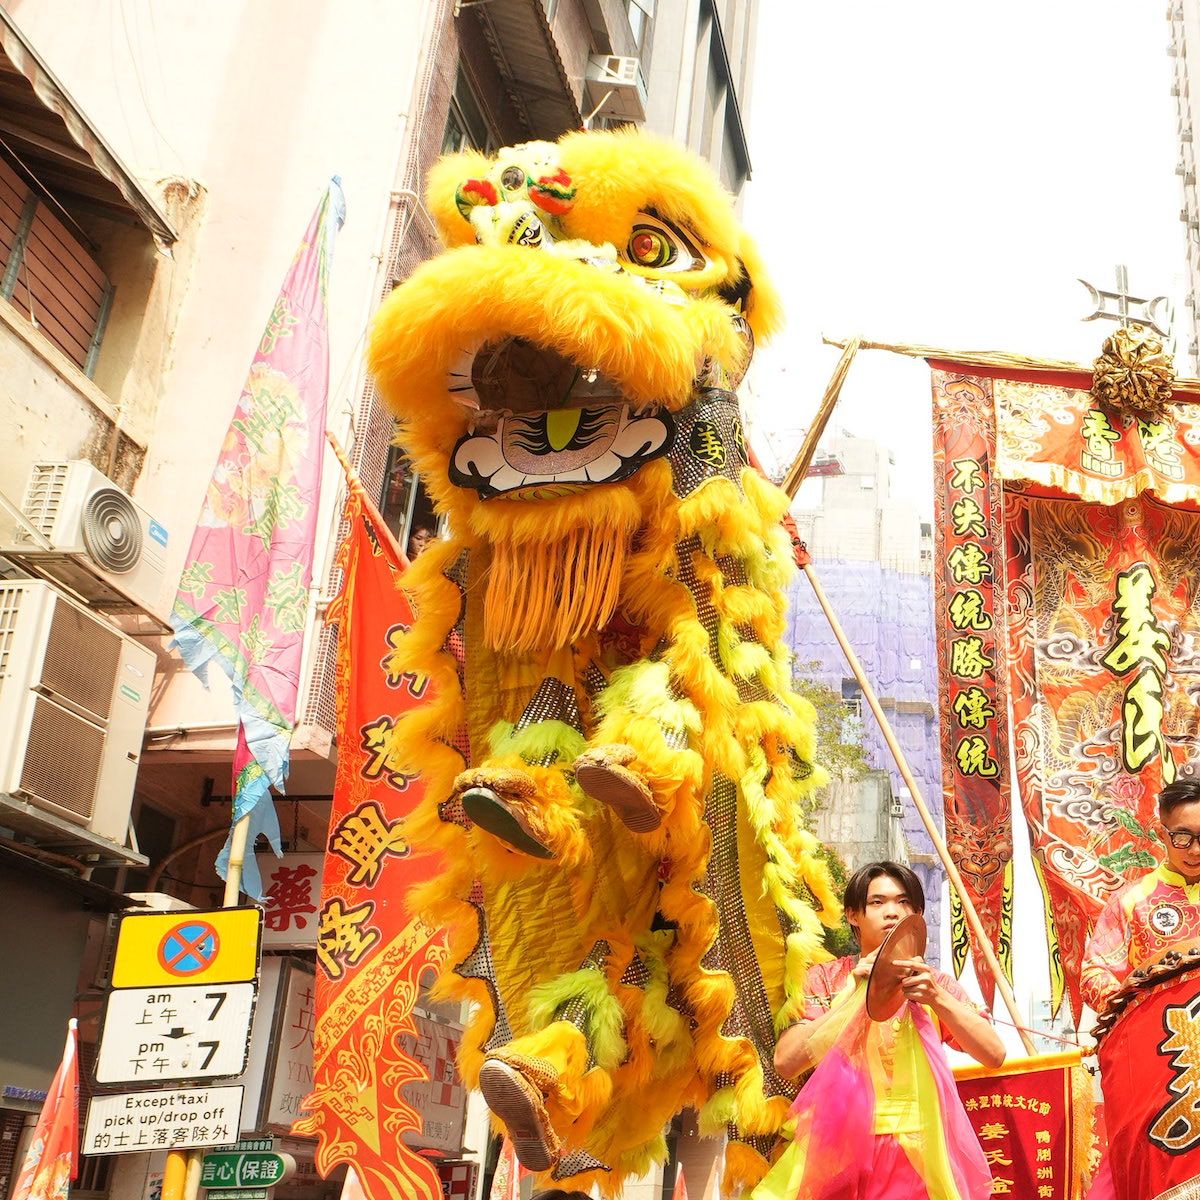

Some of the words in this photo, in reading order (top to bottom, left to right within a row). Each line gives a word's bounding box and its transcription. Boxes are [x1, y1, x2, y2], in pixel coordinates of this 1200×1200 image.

[1103, 563, 1176, 784] 姜氏
[147, 993, 171, 1004] am
[205, 992, 227, 1021] 7
[135, 1009, 177, 1025] 上午
[138, 1042, 164, 1055] pm
[198, 1041, 220, 1070] 7
[129, 1058, 170, 1075] 下午
[125, 1096, 175, 1109] Except
[181, 1093, 209, 1105] taxi
[104, 1112, 133, 1128] pick
[139, 1110, 198, 1126] up/drop
[203, 1107, 224, 1120] off
[94, 1124, 229, 1149] 的士上落客除外
